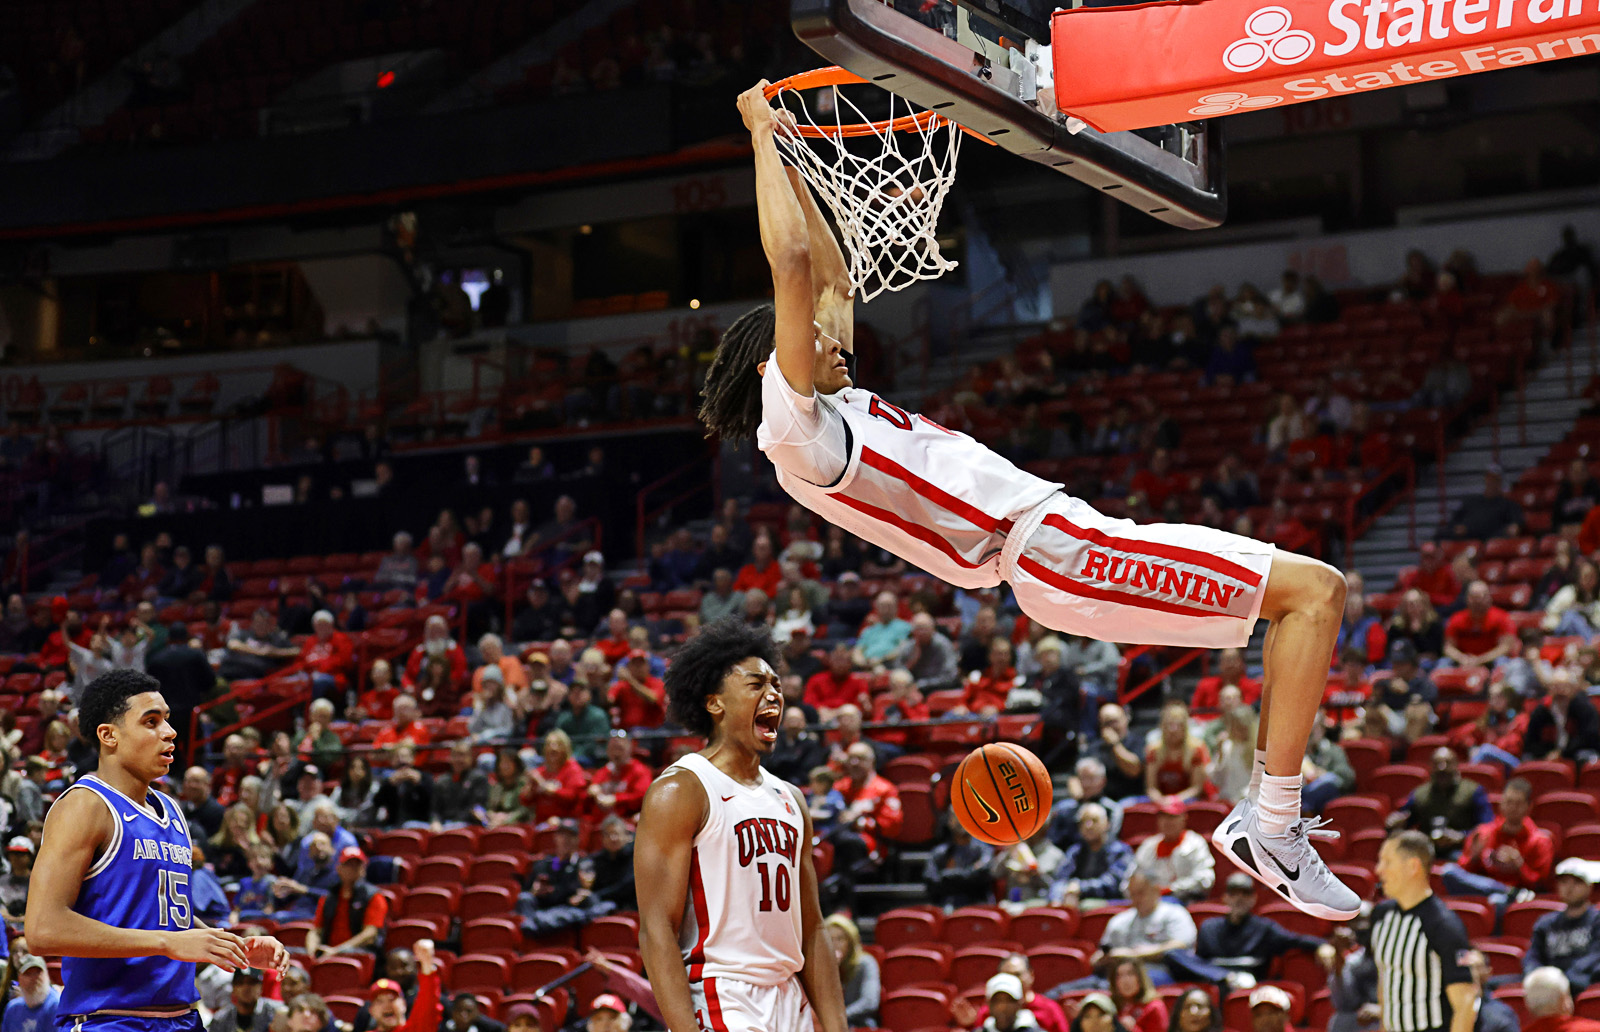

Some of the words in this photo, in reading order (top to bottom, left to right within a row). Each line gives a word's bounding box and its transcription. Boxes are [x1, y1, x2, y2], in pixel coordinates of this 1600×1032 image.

[1323, 0, 1490, 57] State
[1283, 60, 1459, 99] State
[1080, 549, 1244, 608] RUNNIN'
[998, 762, 1030, 814] ELITE
[133, 839, 161, 860] AIR
[160, 841, 193, 869] FORC
[734, 818, 798, 868] UNLV
[158, 869, 191, 929] 15
[757, 863, 791, 912] 10
